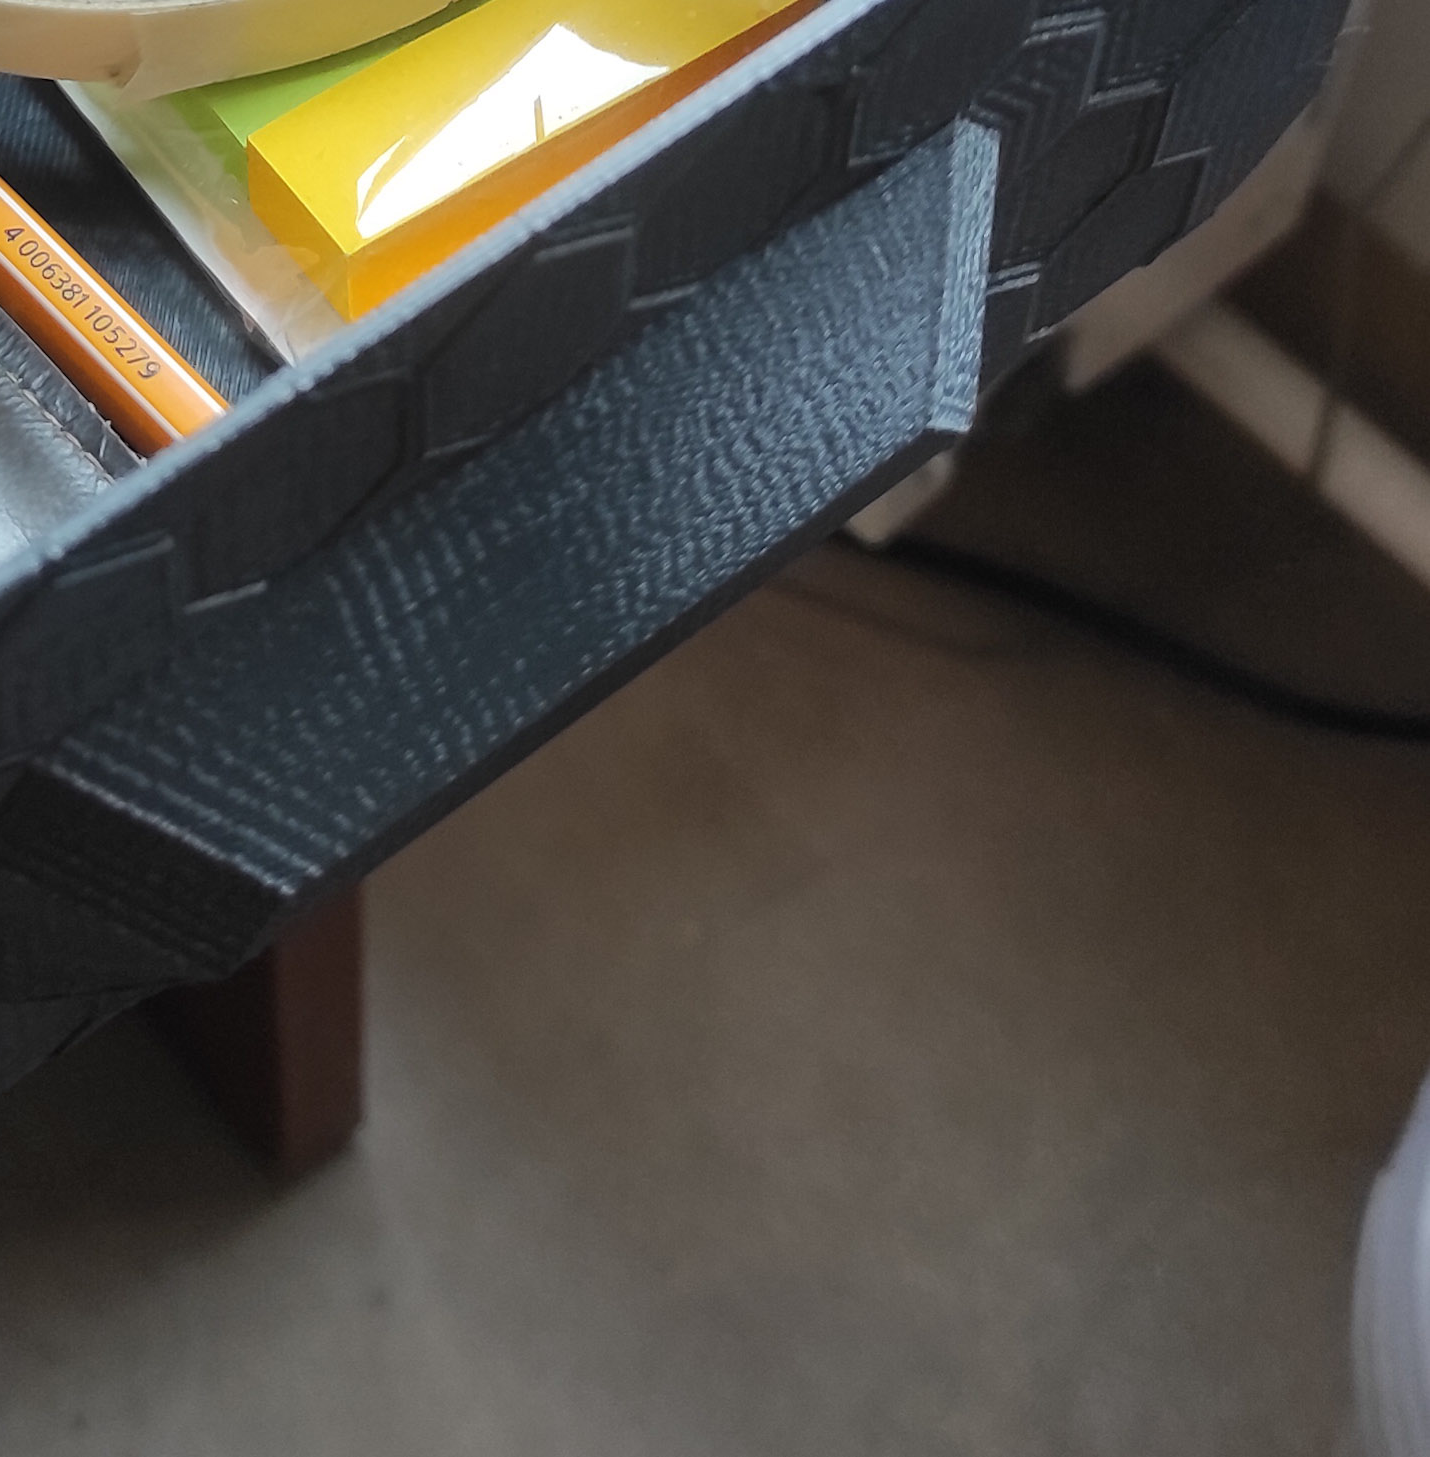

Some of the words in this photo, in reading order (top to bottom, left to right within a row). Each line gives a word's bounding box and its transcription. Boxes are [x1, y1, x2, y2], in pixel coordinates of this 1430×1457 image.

[3, 226, 26, 243] 4
[18, 239, 90, 309] 006381
[83, 304, 161, 379] 105279
